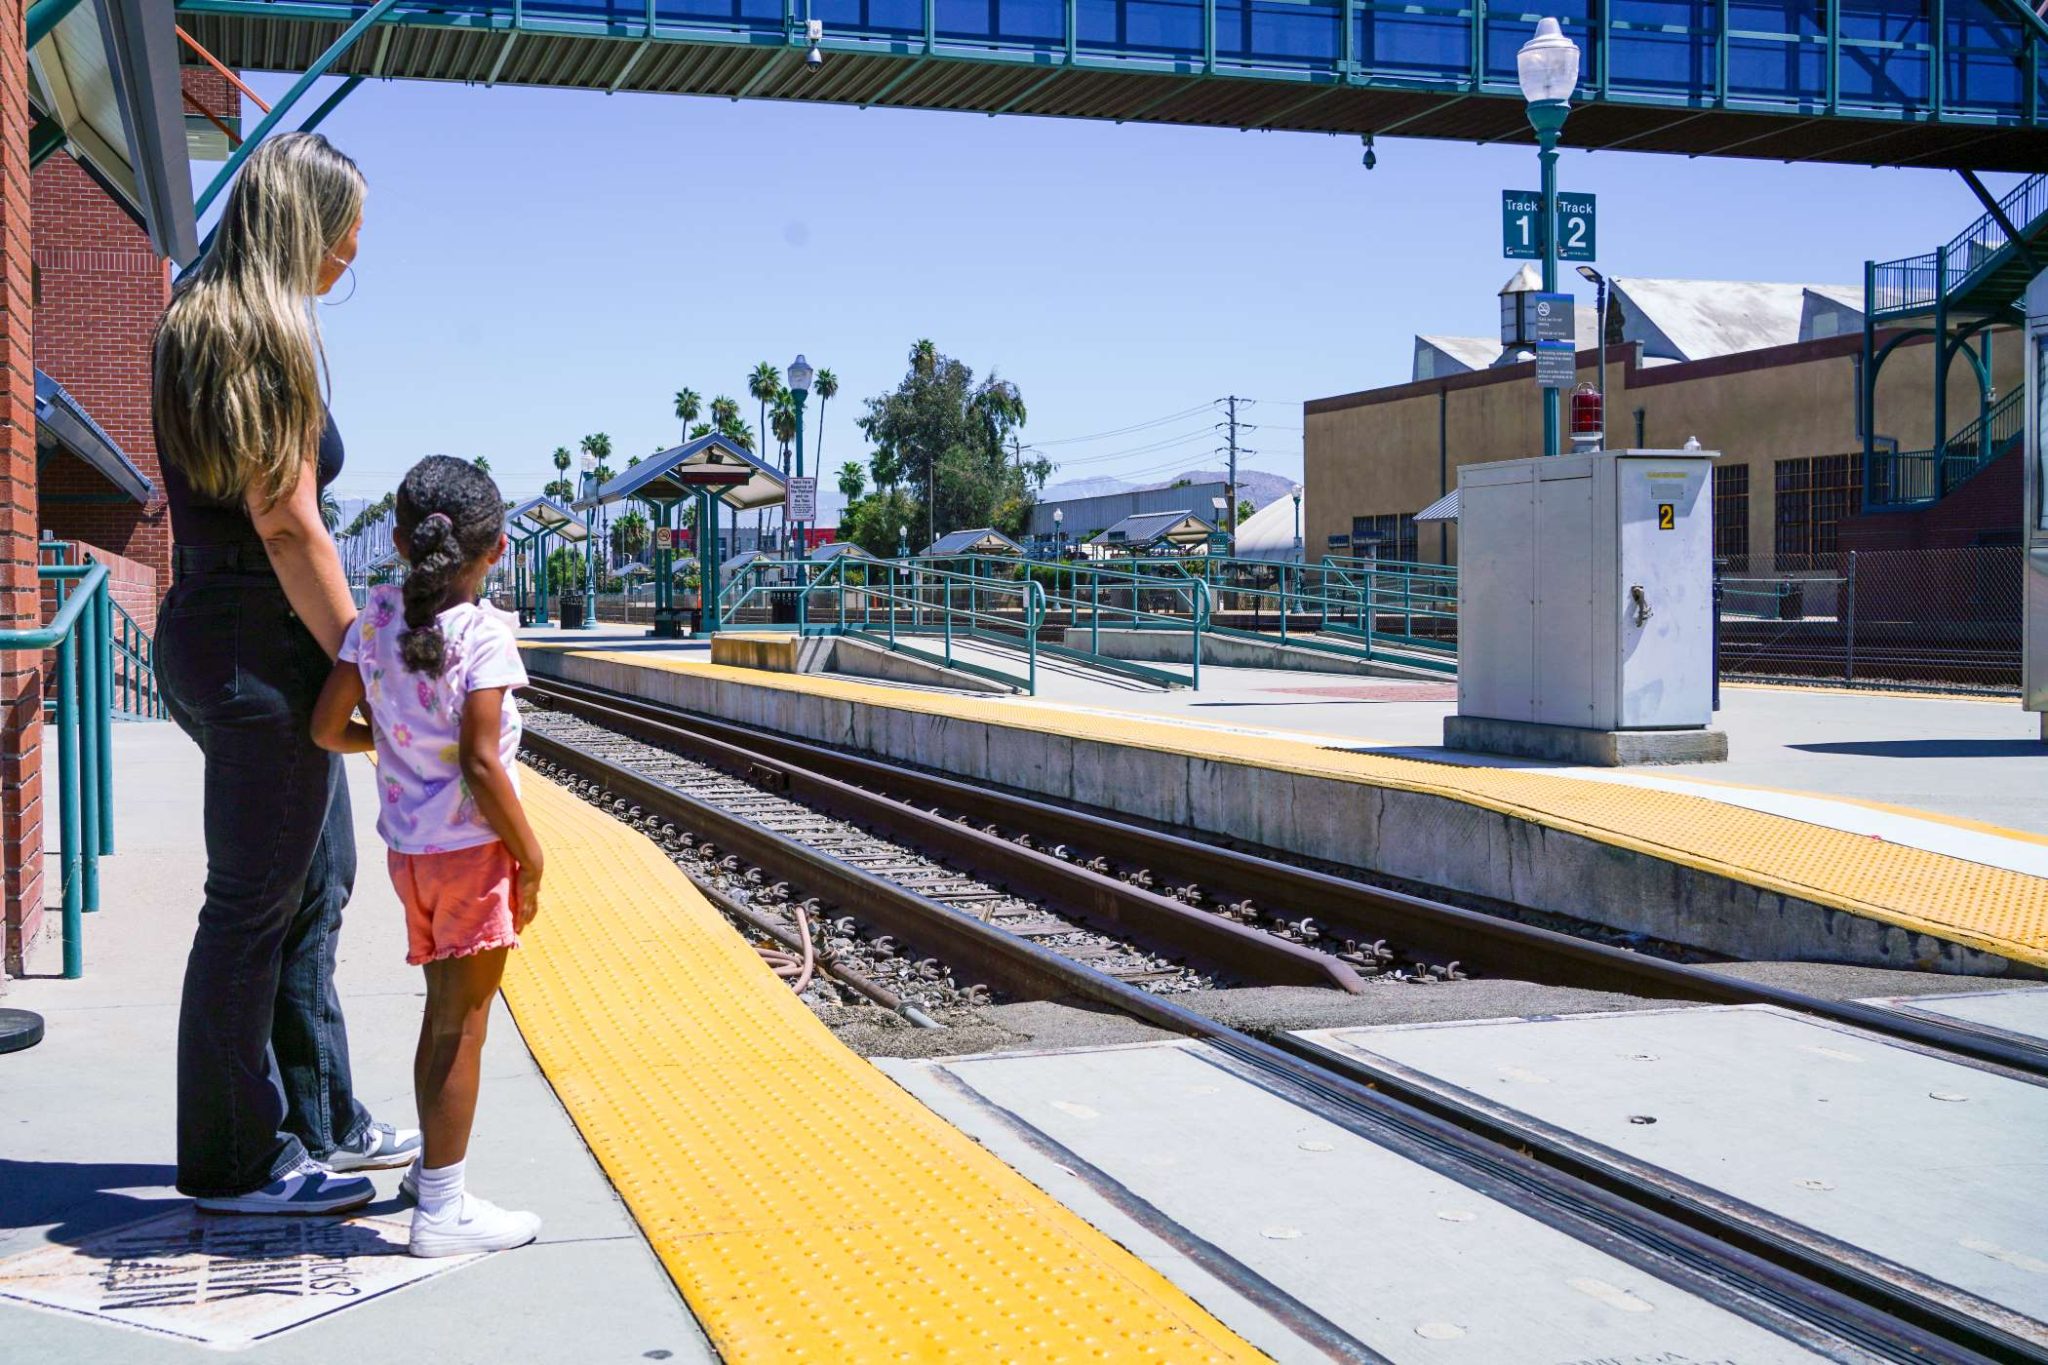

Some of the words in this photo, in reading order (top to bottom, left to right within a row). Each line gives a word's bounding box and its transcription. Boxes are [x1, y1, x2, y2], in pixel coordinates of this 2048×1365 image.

[1505, 199, 1538, 212] Track
[1560, 201, 1593, 214] Track
[1516, 215, 1529, 246] 1
[1567, 217, 1586, 248] 2
[1660, 505, 1673, 529] 2
[205, 1222, 303, 1303] THINK
